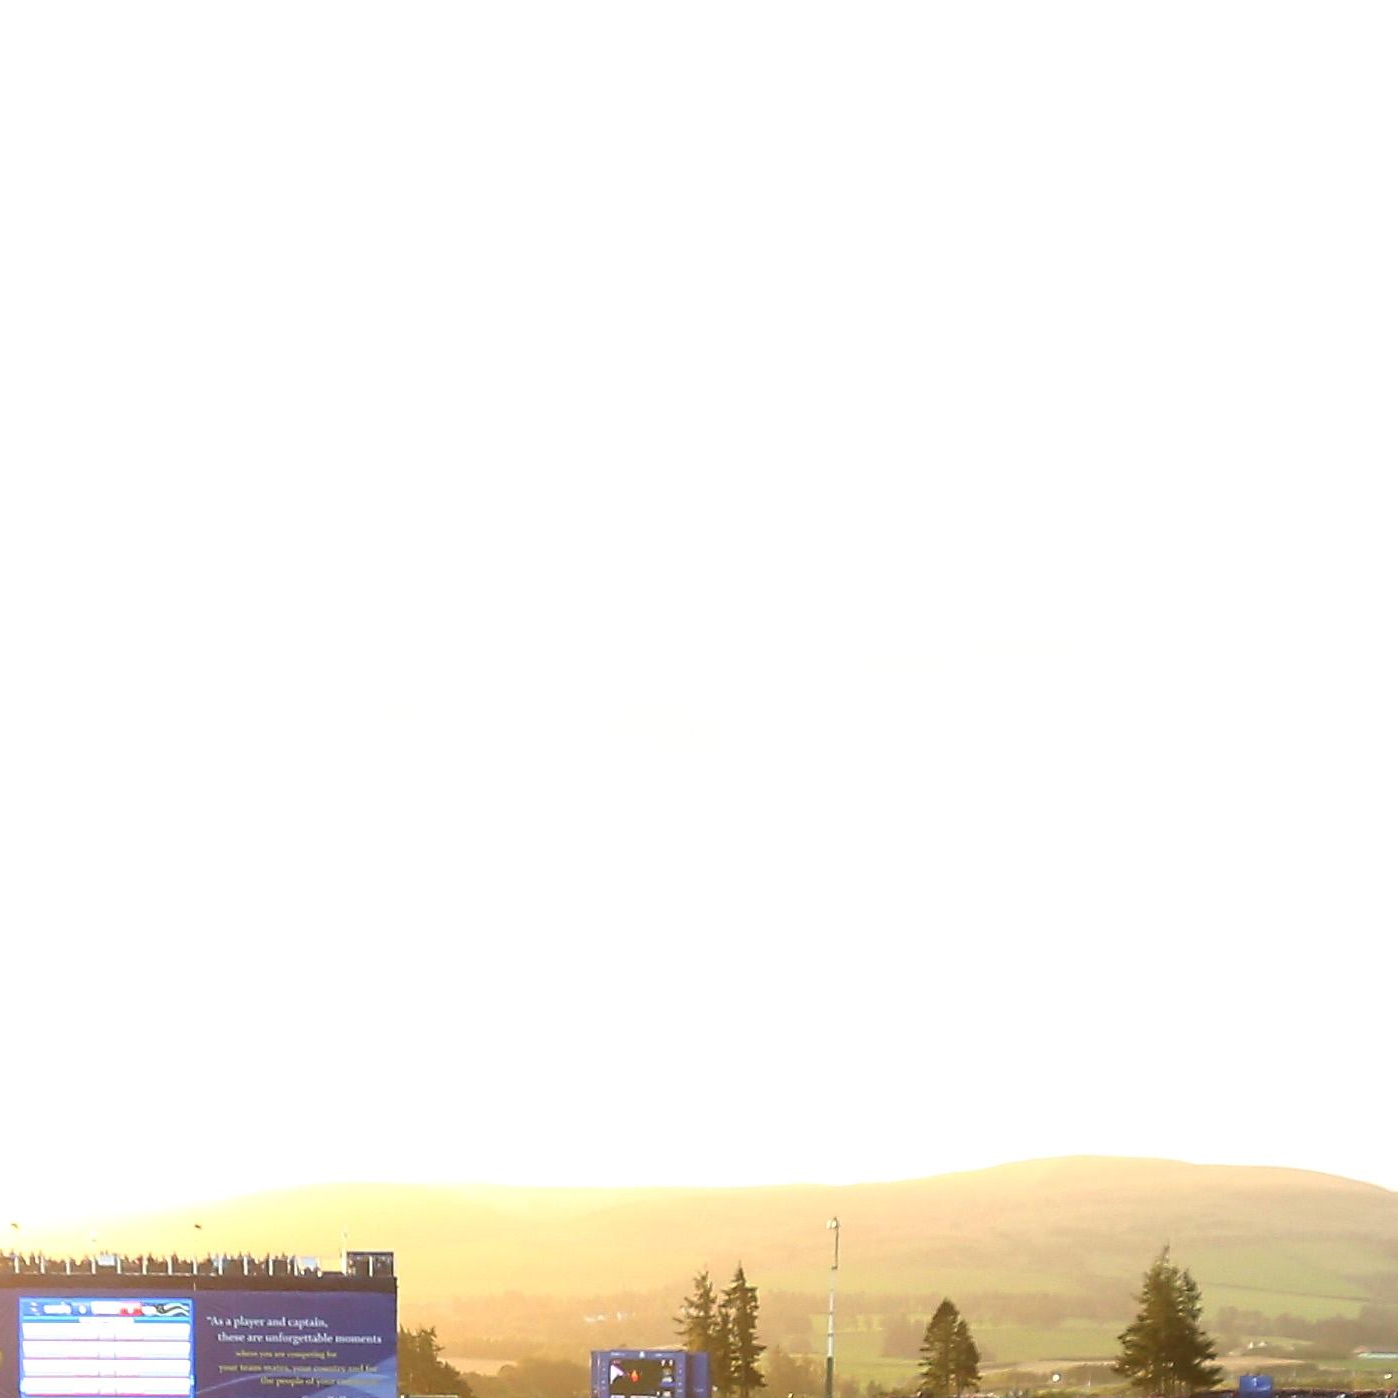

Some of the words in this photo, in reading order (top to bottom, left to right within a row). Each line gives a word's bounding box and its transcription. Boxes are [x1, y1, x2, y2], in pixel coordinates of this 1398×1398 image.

[225, 1319, 232, 1327] a
[234, 1316, 264, 1329] player
[267, 1316, 286, 1327] and
[288, 1316, 328, 1329] captain,
[218, 1332, 244, 1342] these
[266, 1332, 333, 1345] unforgettable
[335, 1335, 382, 1343] moments
